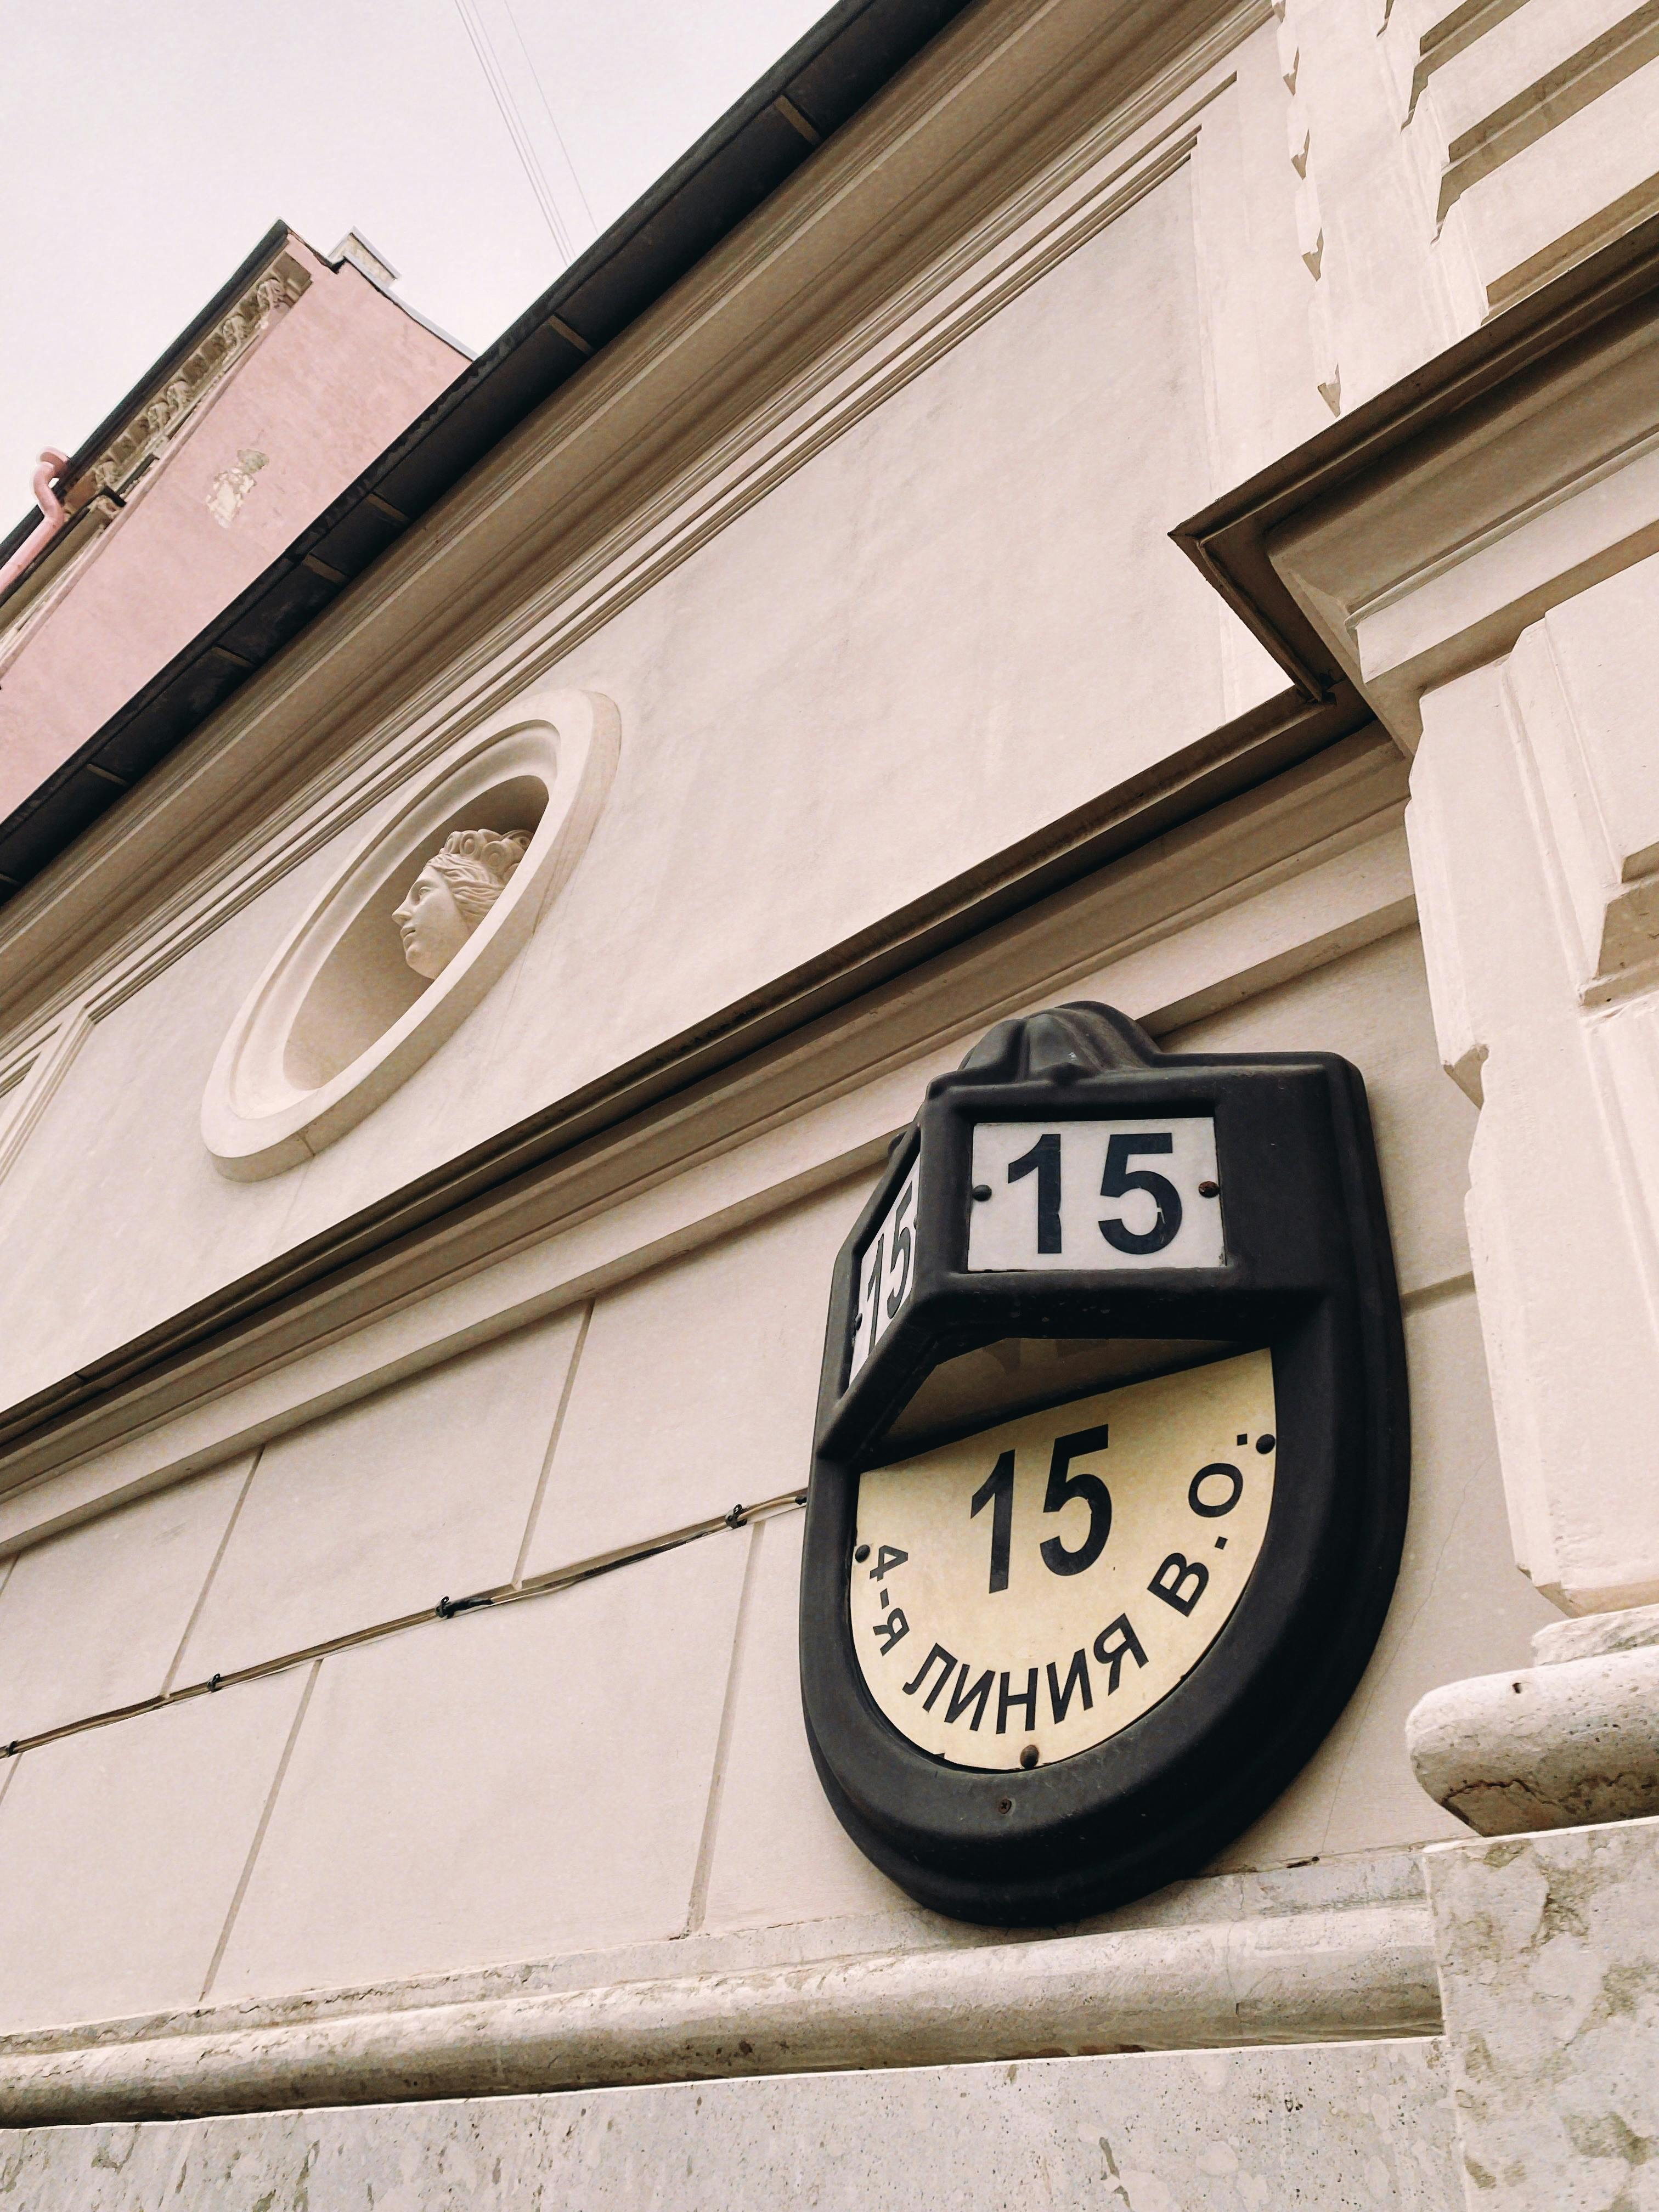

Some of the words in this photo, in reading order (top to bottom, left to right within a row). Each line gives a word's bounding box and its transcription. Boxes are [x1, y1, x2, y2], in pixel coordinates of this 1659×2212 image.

[867, 1180, 912, 1357] 15
[1008, 1132, 1183, 1255] 15
[970, 1424, 1113, 1594] 15
[870, 1544, 910, 1656] 4-Я
[902, 1613, 1149, 1735] ЛИНИЯ
